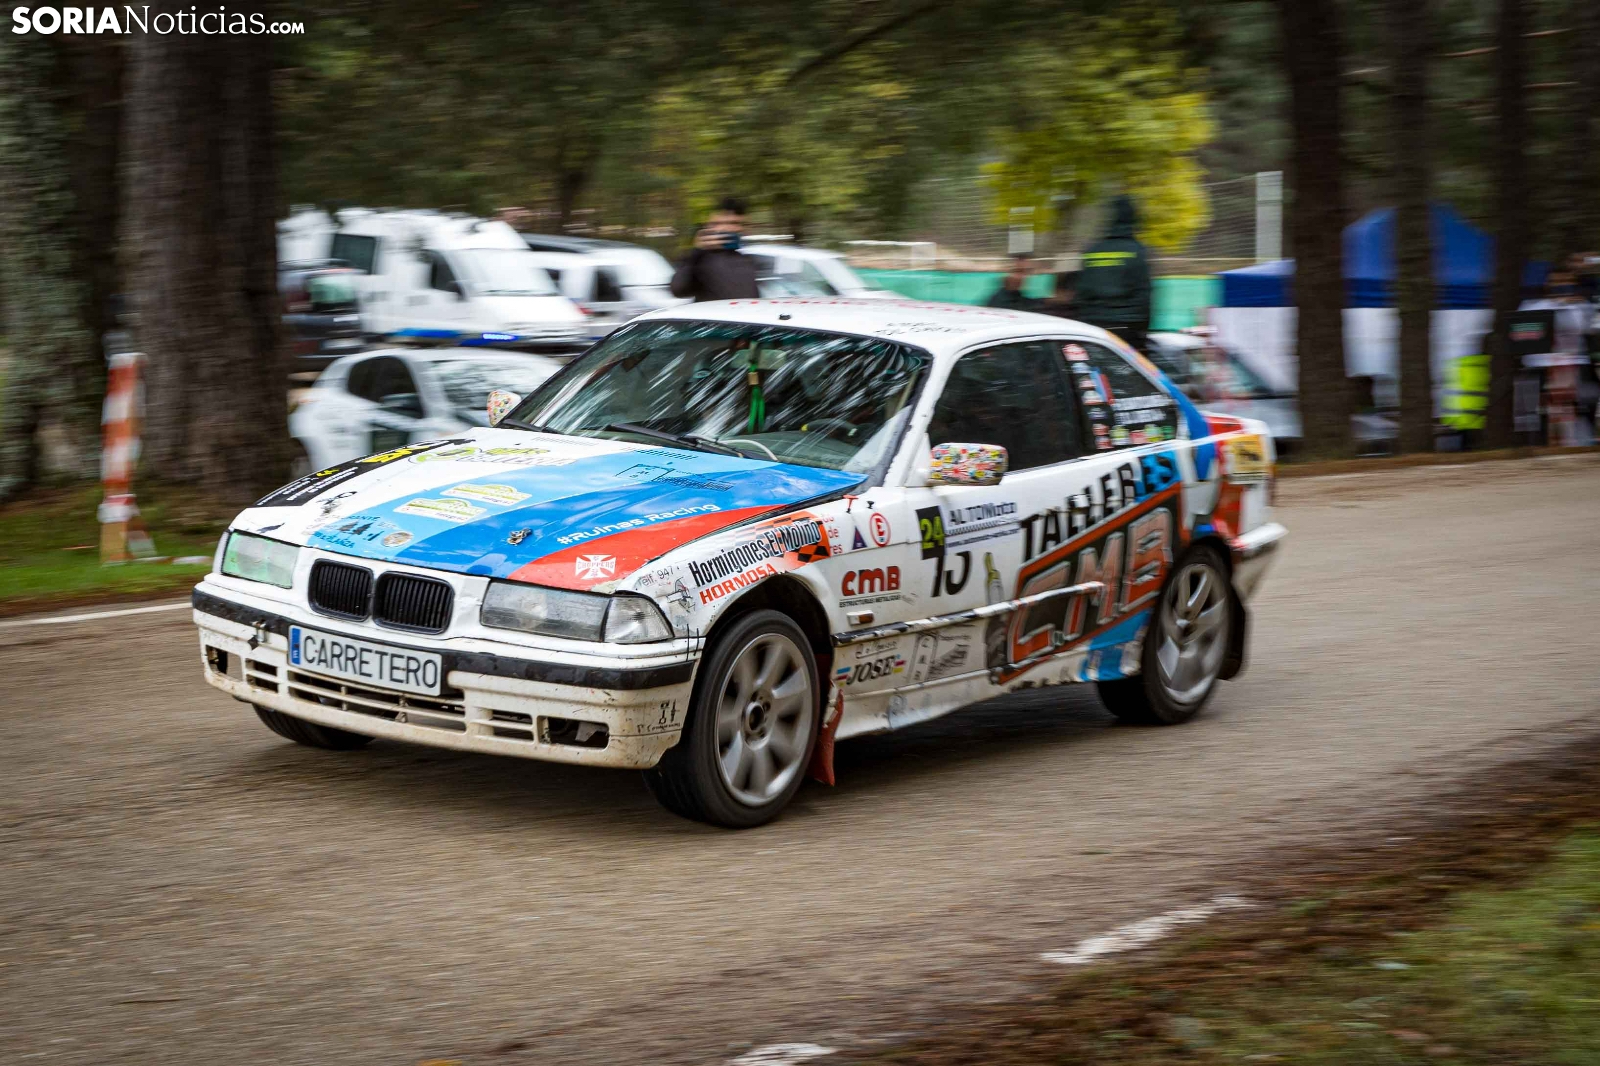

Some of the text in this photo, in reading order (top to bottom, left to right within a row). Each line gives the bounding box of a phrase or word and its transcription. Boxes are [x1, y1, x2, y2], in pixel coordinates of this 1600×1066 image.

[557, 504, 721, 545] #Ruinas Racing
[920, 516, 945, 549] 24
[688, 539, 770, 588] Hormigones
[699, 563, 778, 605] HORMOSA
[303, 635, 439, 689] CARRETERO
